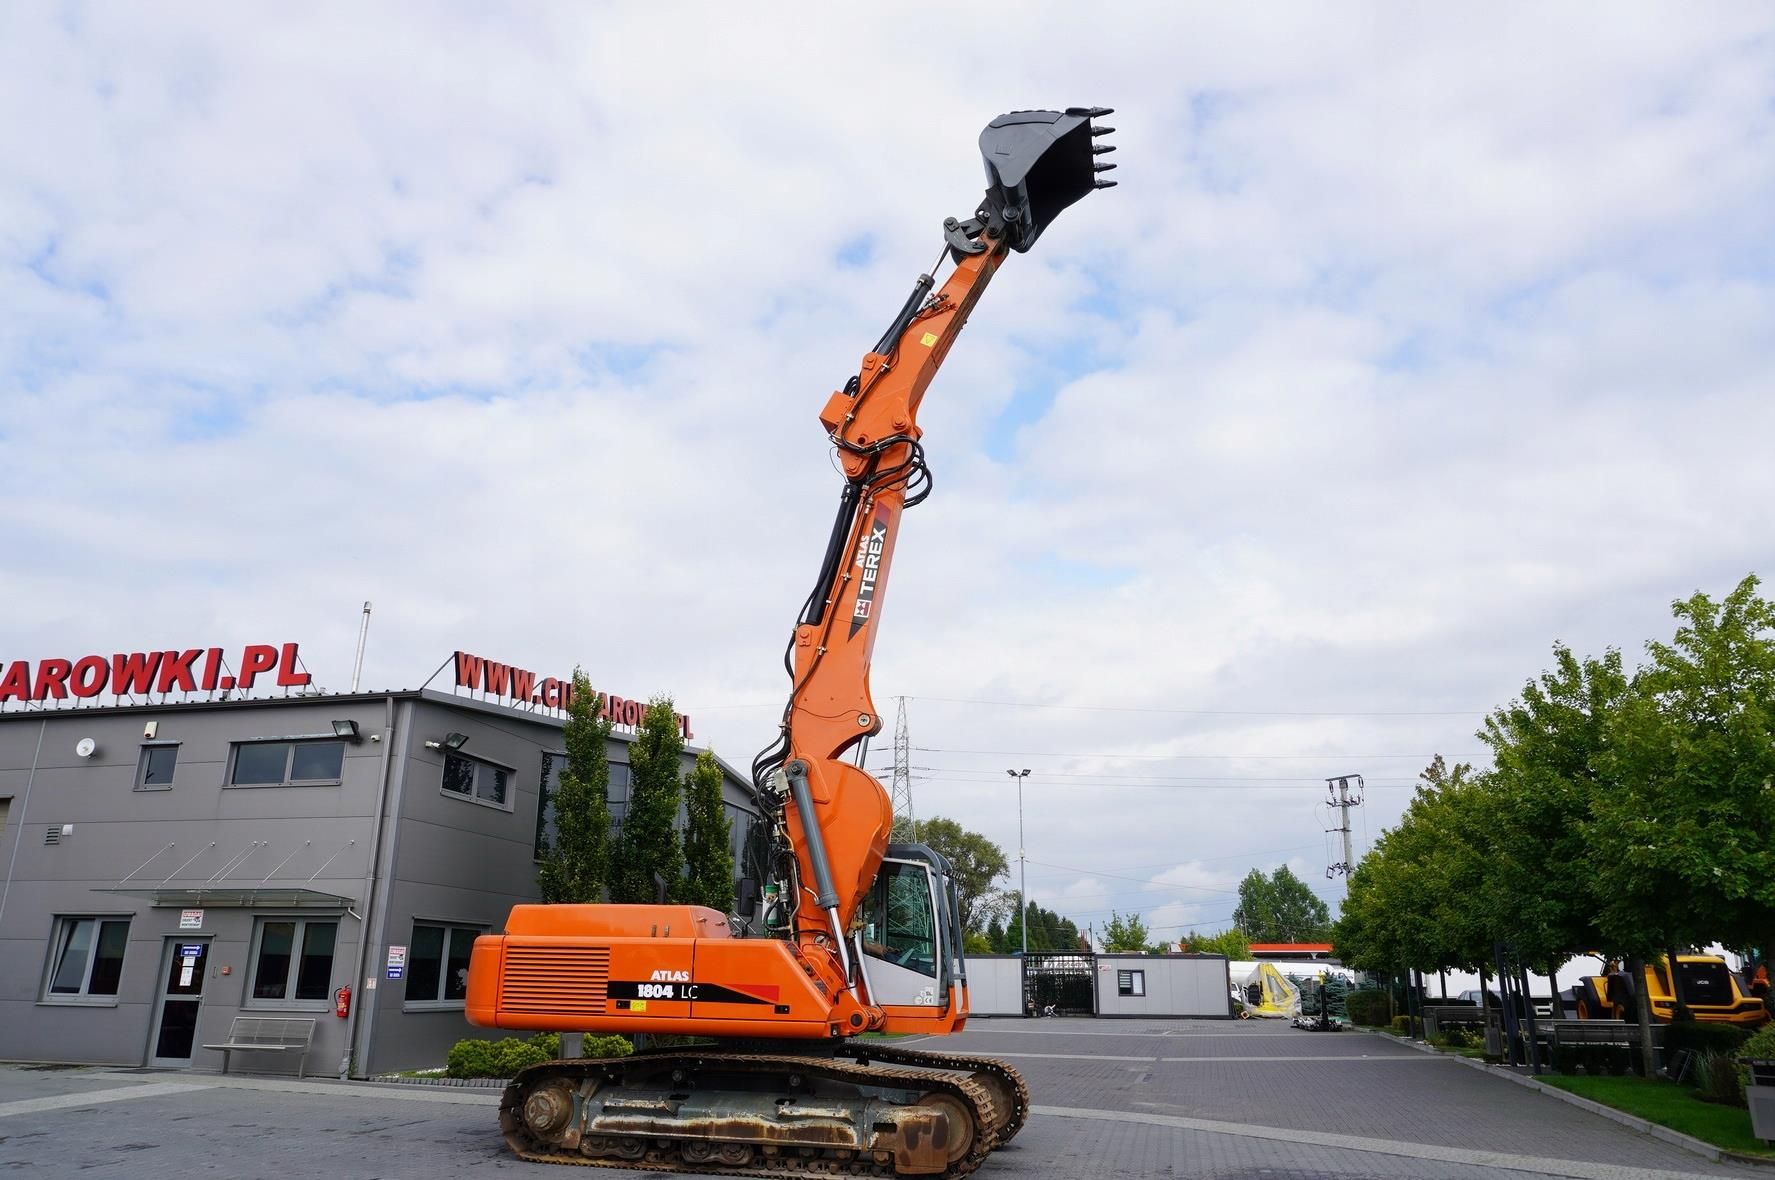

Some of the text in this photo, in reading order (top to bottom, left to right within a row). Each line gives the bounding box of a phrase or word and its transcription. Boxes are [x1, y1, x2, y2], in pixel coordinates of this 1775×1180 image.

[856, 535, 870, 568] ATLAS
[860, 527, 887, 595] TEREX
[0, 643, 312, 703] AROWKI.PL
[637, 984, 699, 999] 1804 LC
[651, 970, 689, 981] ATLAS
